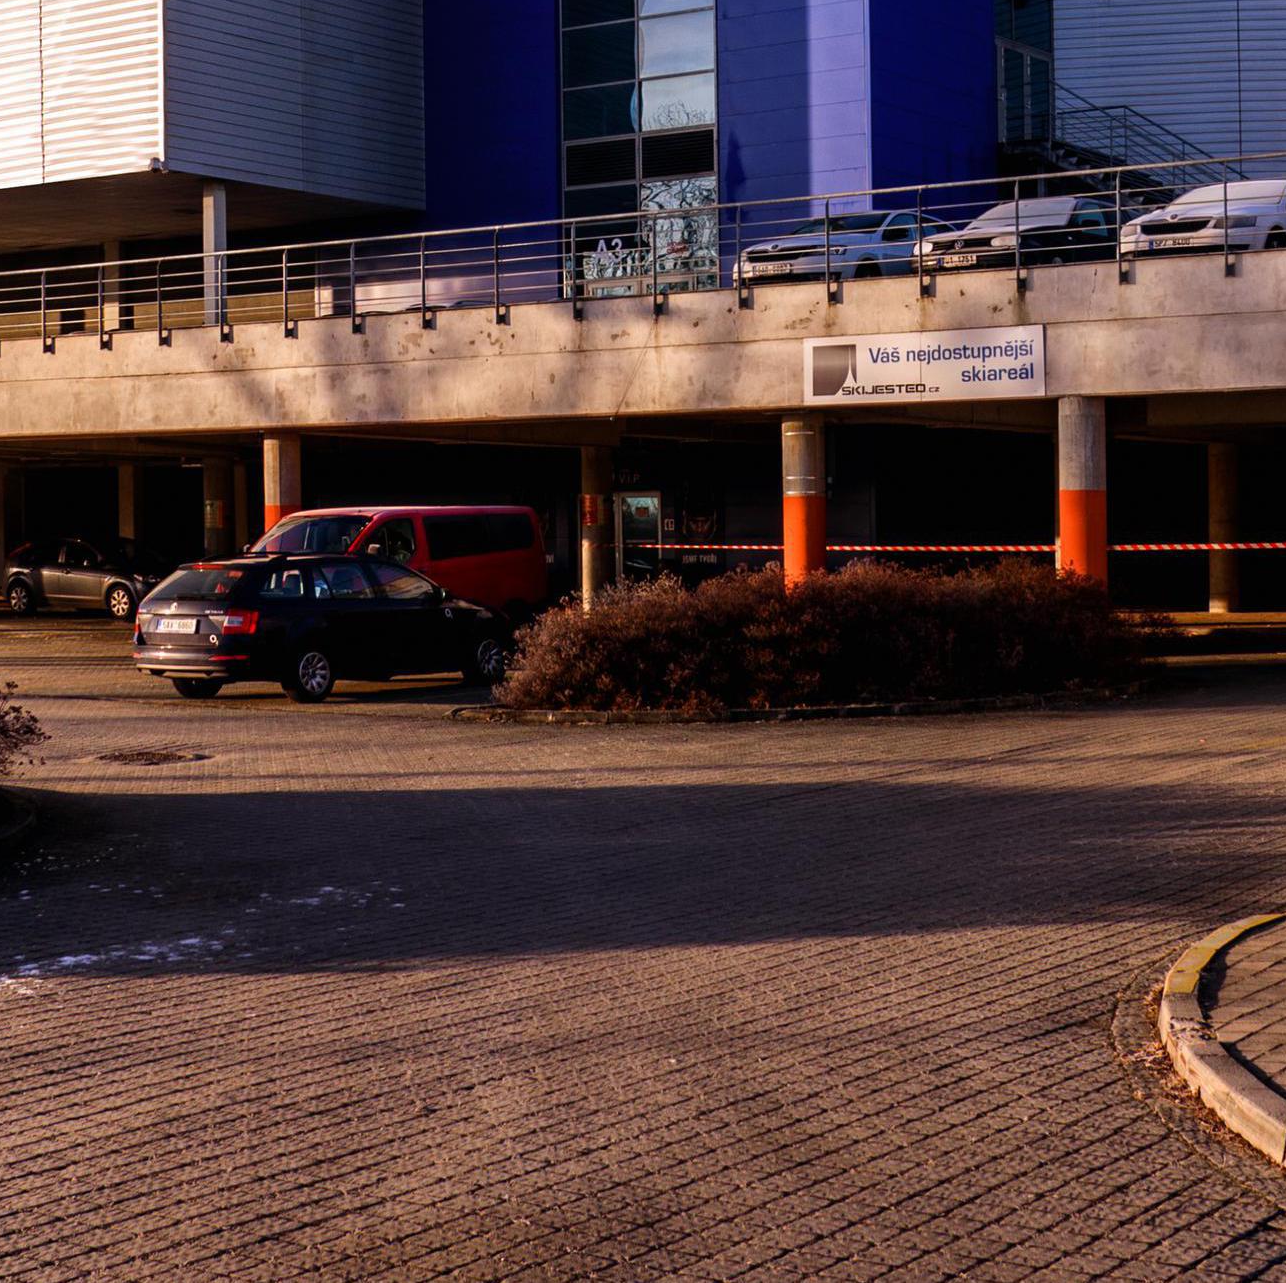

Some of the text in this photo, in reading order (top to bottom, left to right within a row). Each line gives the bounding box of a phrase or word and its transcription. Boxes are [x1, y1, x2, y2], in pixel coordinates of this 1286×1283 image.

[594, 238, 623, 264] A3
[868, 339, 1034, 365] Váš nejdostupnější
[961, 362, 1034, 383] skiareál
